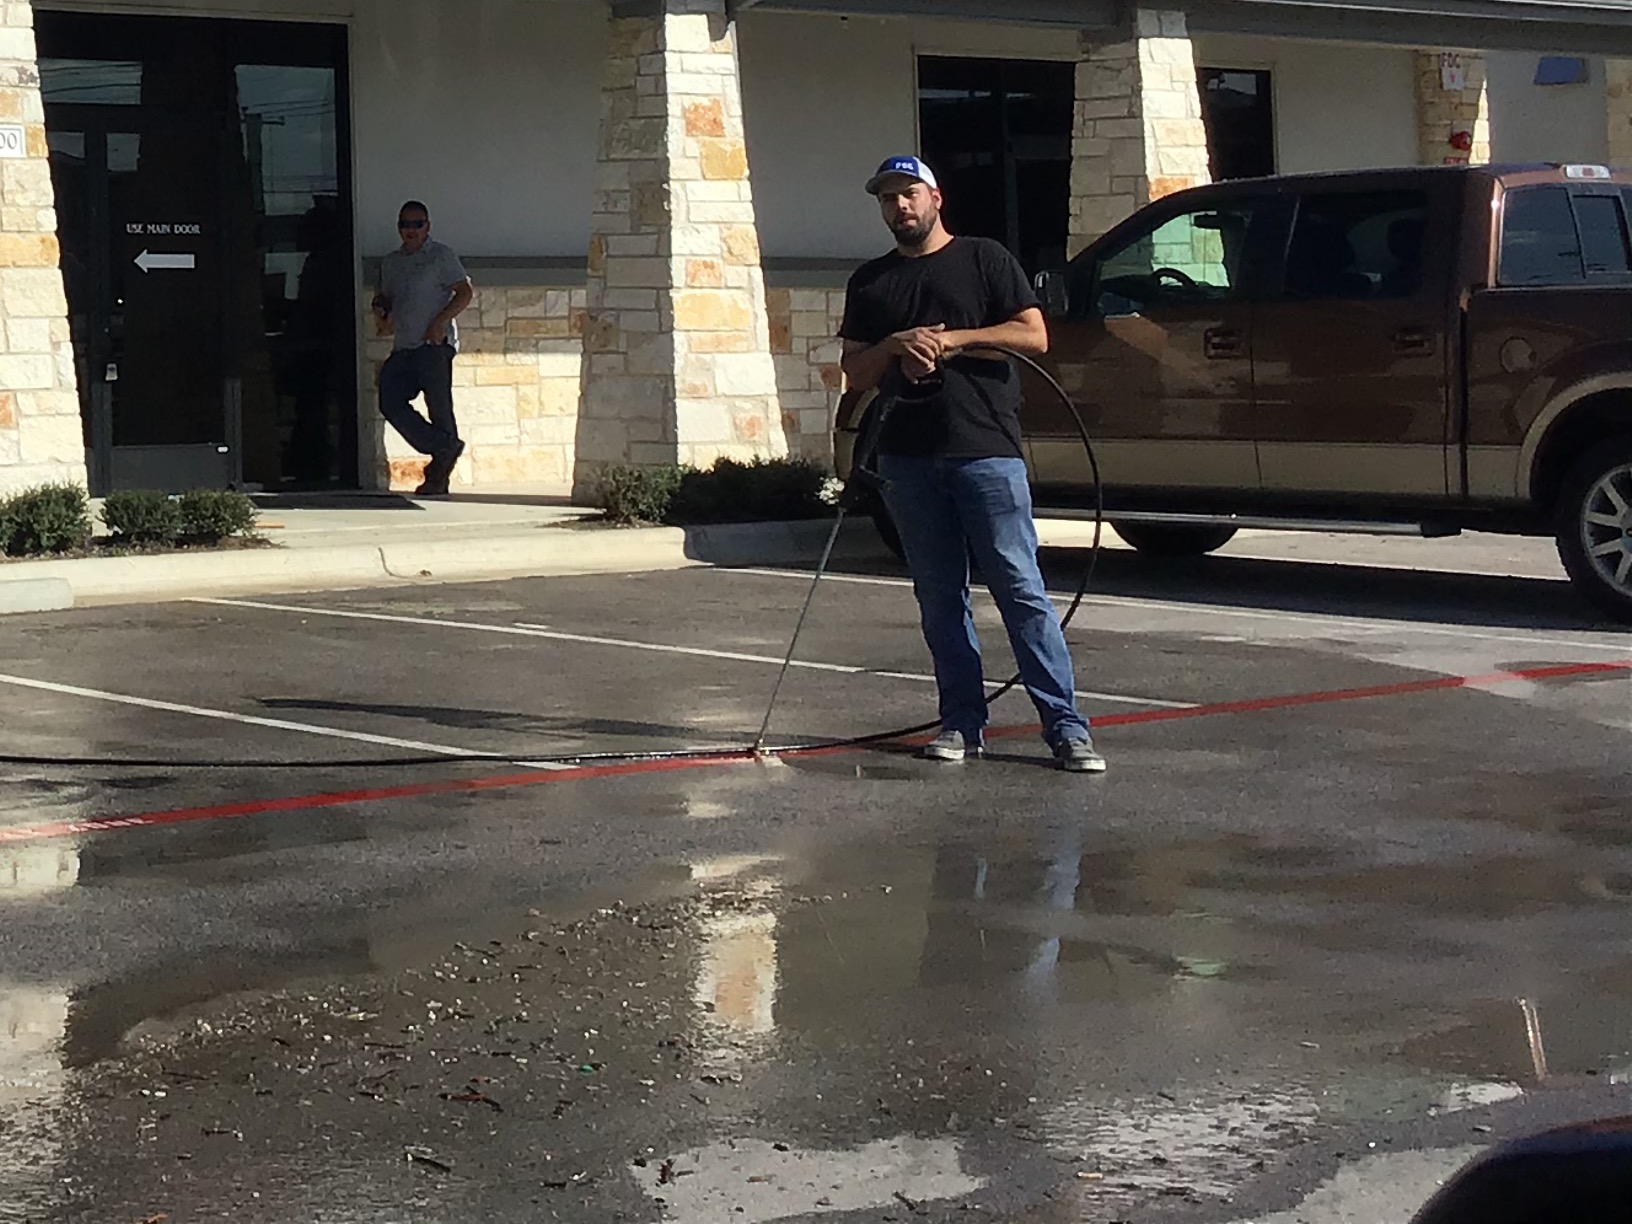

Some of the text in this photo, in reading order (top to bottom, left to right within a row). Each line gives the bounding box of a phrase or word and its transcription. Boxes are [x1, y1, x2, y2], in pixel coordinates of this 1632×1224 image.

[126, 223, 201, 235] USE MAIN DOOR
